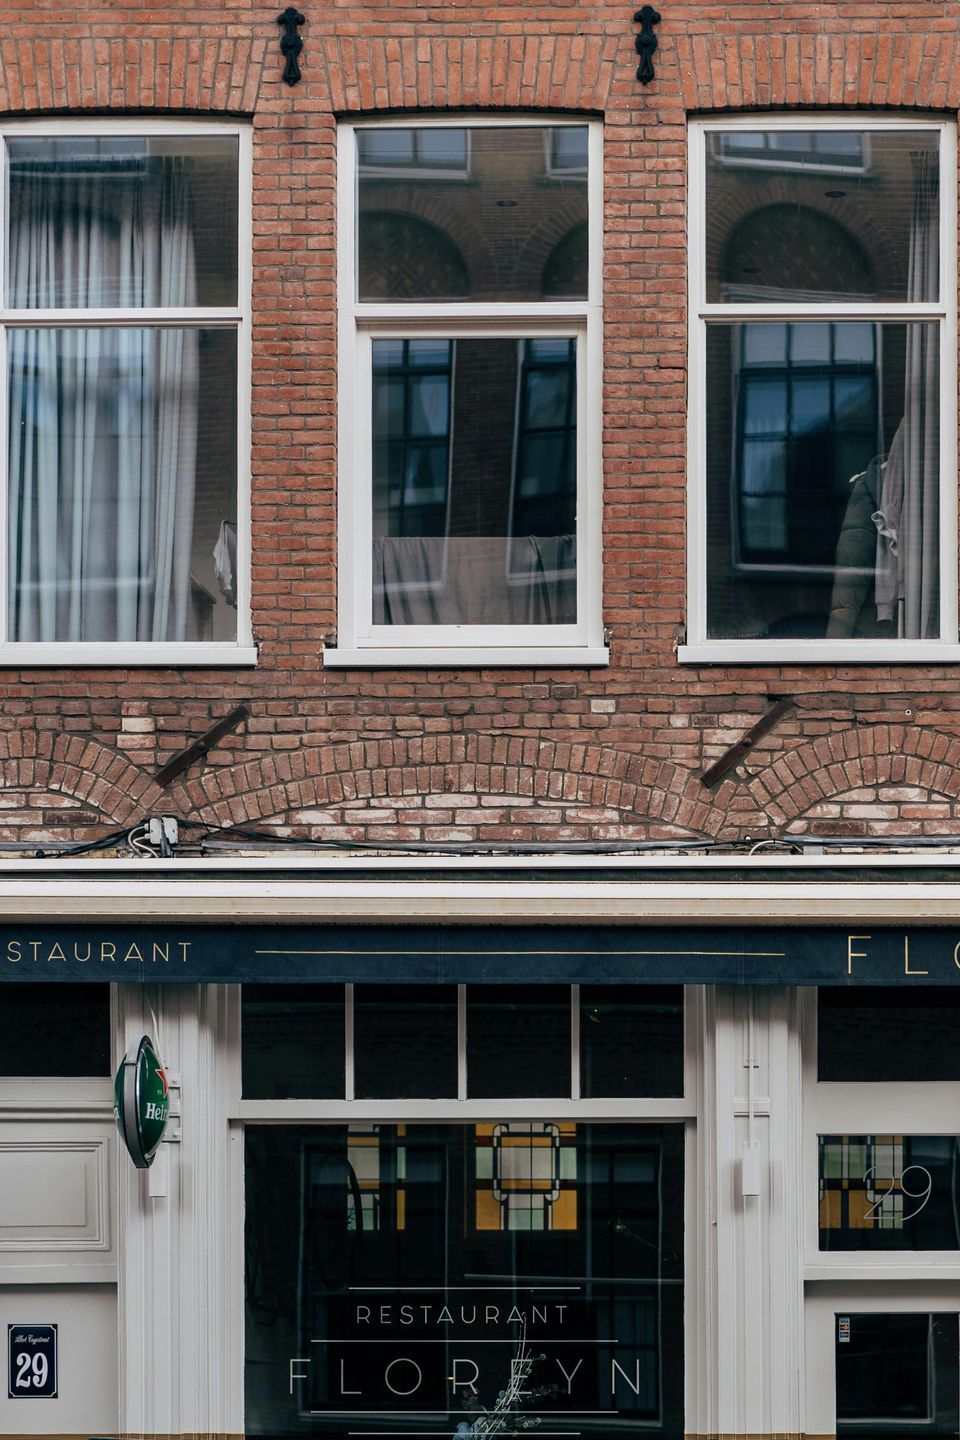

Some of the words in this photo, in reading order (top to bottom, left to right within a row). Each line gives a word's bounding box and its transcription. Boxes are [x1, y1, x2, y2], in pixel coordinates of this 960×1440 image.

[7, 941, 192, 962] STAURANT
[863, 1165, 931, 1221] 29
[356, 1305, 568, 1325] RESTAURANT
[16, 1352, 48, 1388] 29
[289, 1358, 640, 1395] FLOREYN
